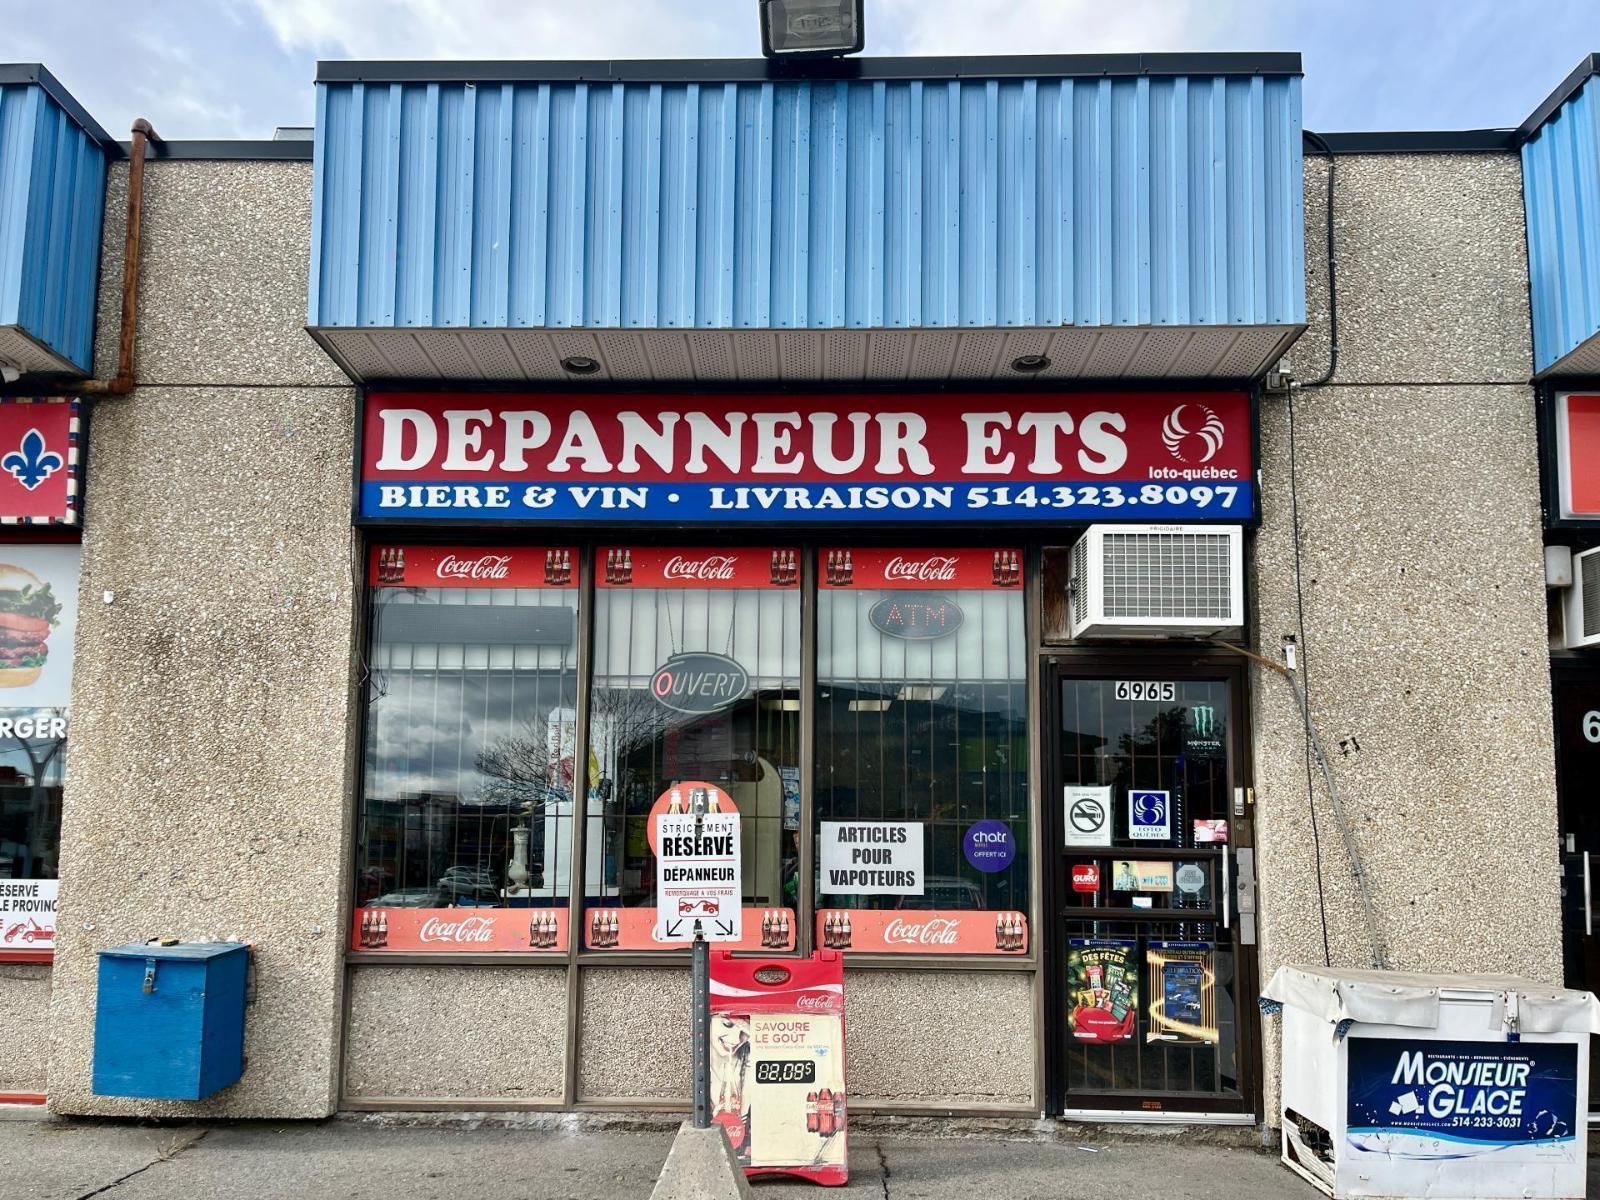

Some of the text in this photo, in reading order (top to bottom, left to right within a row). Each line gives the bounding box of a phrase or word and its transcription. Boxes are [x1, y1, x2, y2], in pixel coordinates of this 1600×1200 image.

[376, 409, 1127, 475] DEPANNEUR ETS
[1149, 466, 1238, 481] loto-québec
[379, 485, 1238, 509] BIERE & VIN LIVRAISON 514.323.8097
[437, 555, 512, 579] Coca-Cola
[663, 555, 739, 580] Coca-Cola
[884, 556, 960, 581] Coca-Cola
[886, 604, 945, 627] ATM
[656, 671, 741, 698] OUVERT
[1116, 682, 1174, 700] 6965
[0, 718, 66, 739] RGER
[663, 833, 734, 857] RÉSERVÉ
[838, 827, 907, 843] ARTICLES
[973, 831, 1006, 843] chatr
[852, 848, 892, 865] POUR
[830, 870, 915, 887] VAPOTEURS
[1073, 874, 1098, 882] GURU
[420, 917, 497, 942] Coca-Cola
[884, 918, 961, 944] Coca-Cola
[1082, 953, 1099, 963] DES
[1100, 951, 1125, 963] FÊTES
[797, 994, 834, 1009] Coca-Cola
[755, 1022, 811, 1032] SAVOURE
[755, 1031, 806, 1043] LE GOÛT
[1428, 1083, 1526, 1119] GLACE
